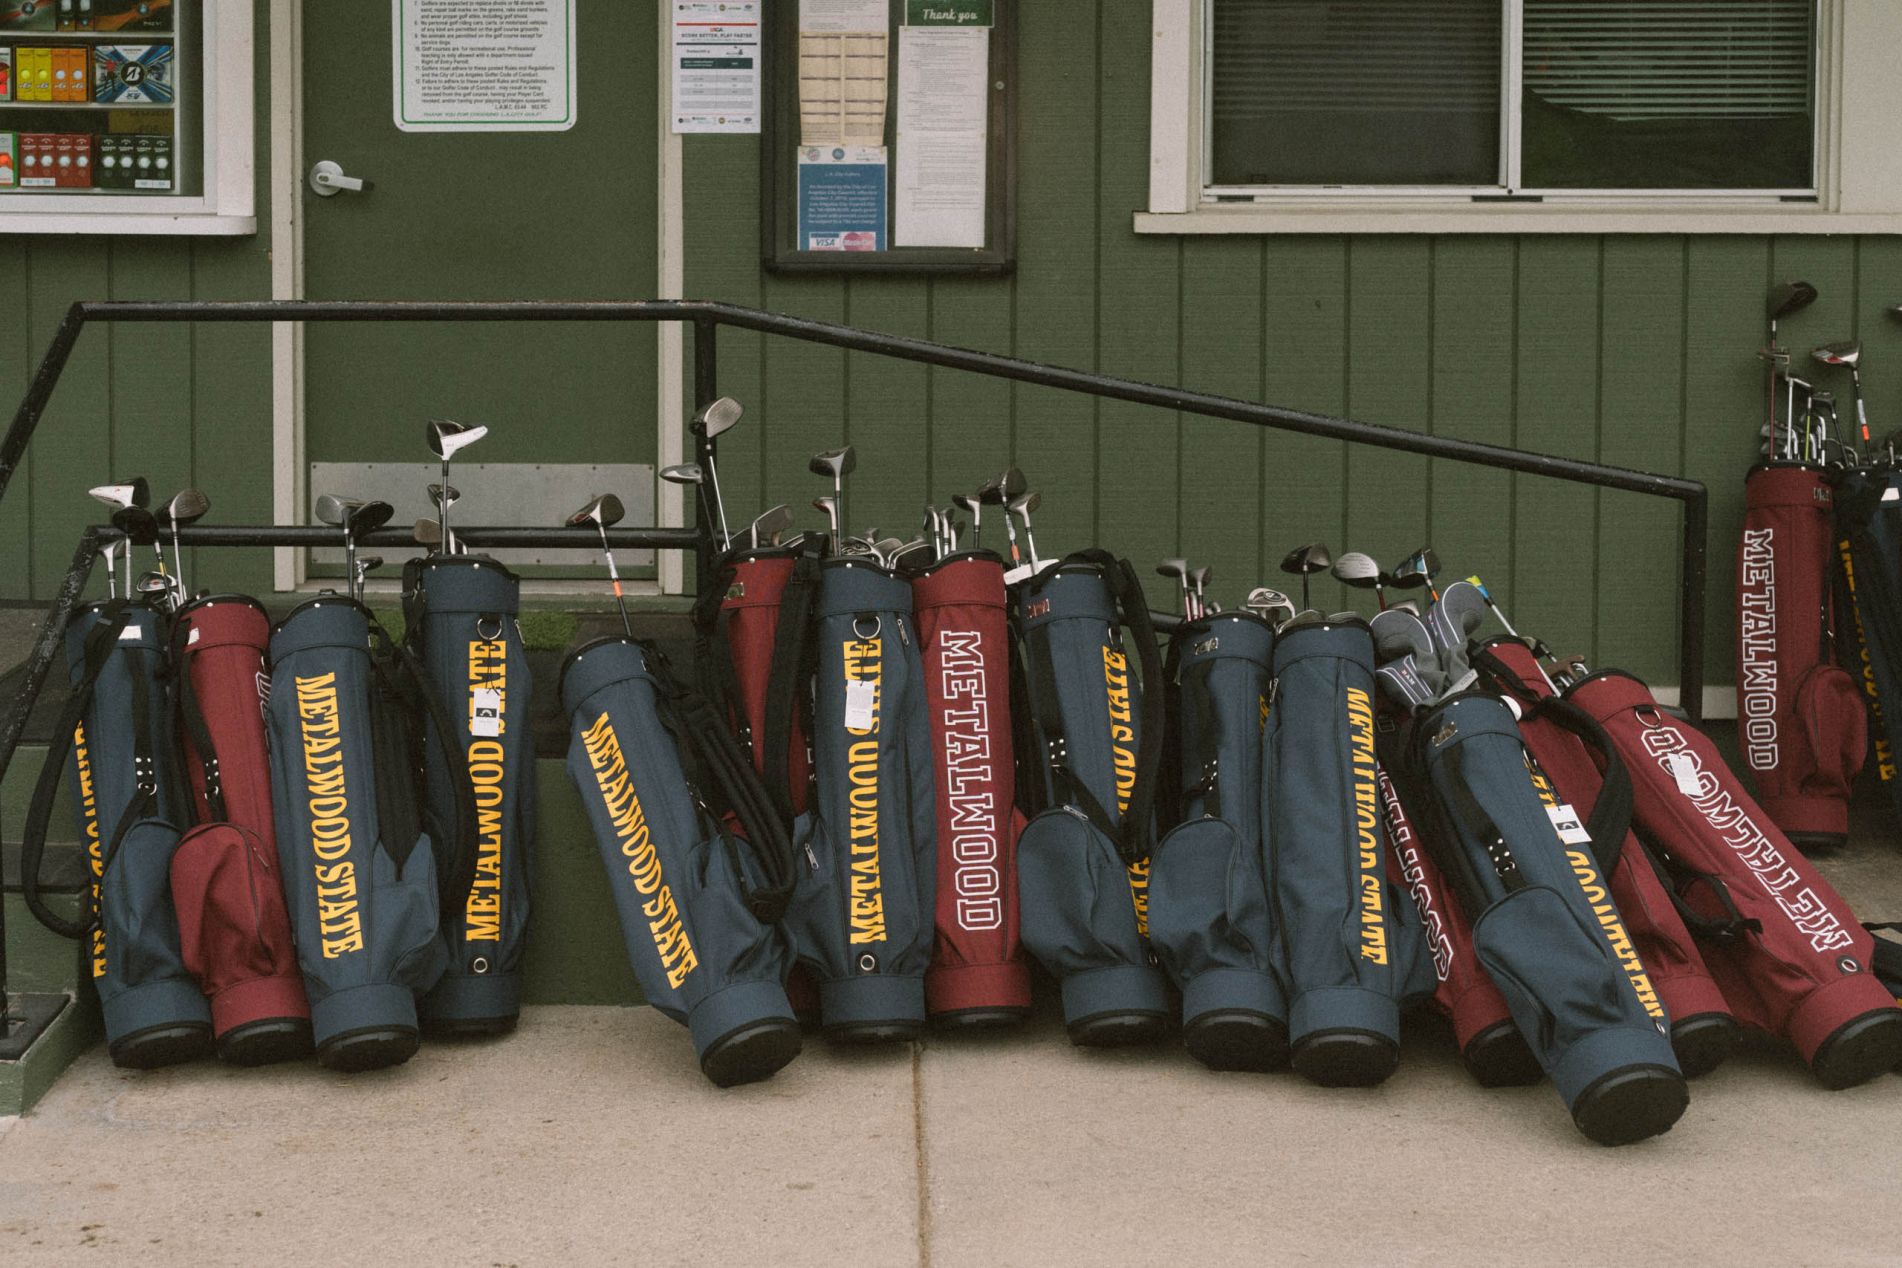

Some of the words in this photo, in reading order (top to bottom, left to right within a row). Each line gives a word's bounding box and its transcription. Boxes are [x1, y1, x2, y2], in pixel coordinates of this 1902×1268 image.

[923, 9, 956, 20] Thank
[958, 12, 978, 23] you
[1103, 646, 1133, 741] STATE
[1741, 527, 1780, 771] METALWOOD
[295, 672, 351, 860] METALWOOD
[581, 713, 663, 900] METALWOOD
[641, 886, 698, 988] STATE
[848, 741, 887, 944] METALWOOD
[941, 630, 1002, 931] METALWOOD
[315, 861, 362, 959] STATE
